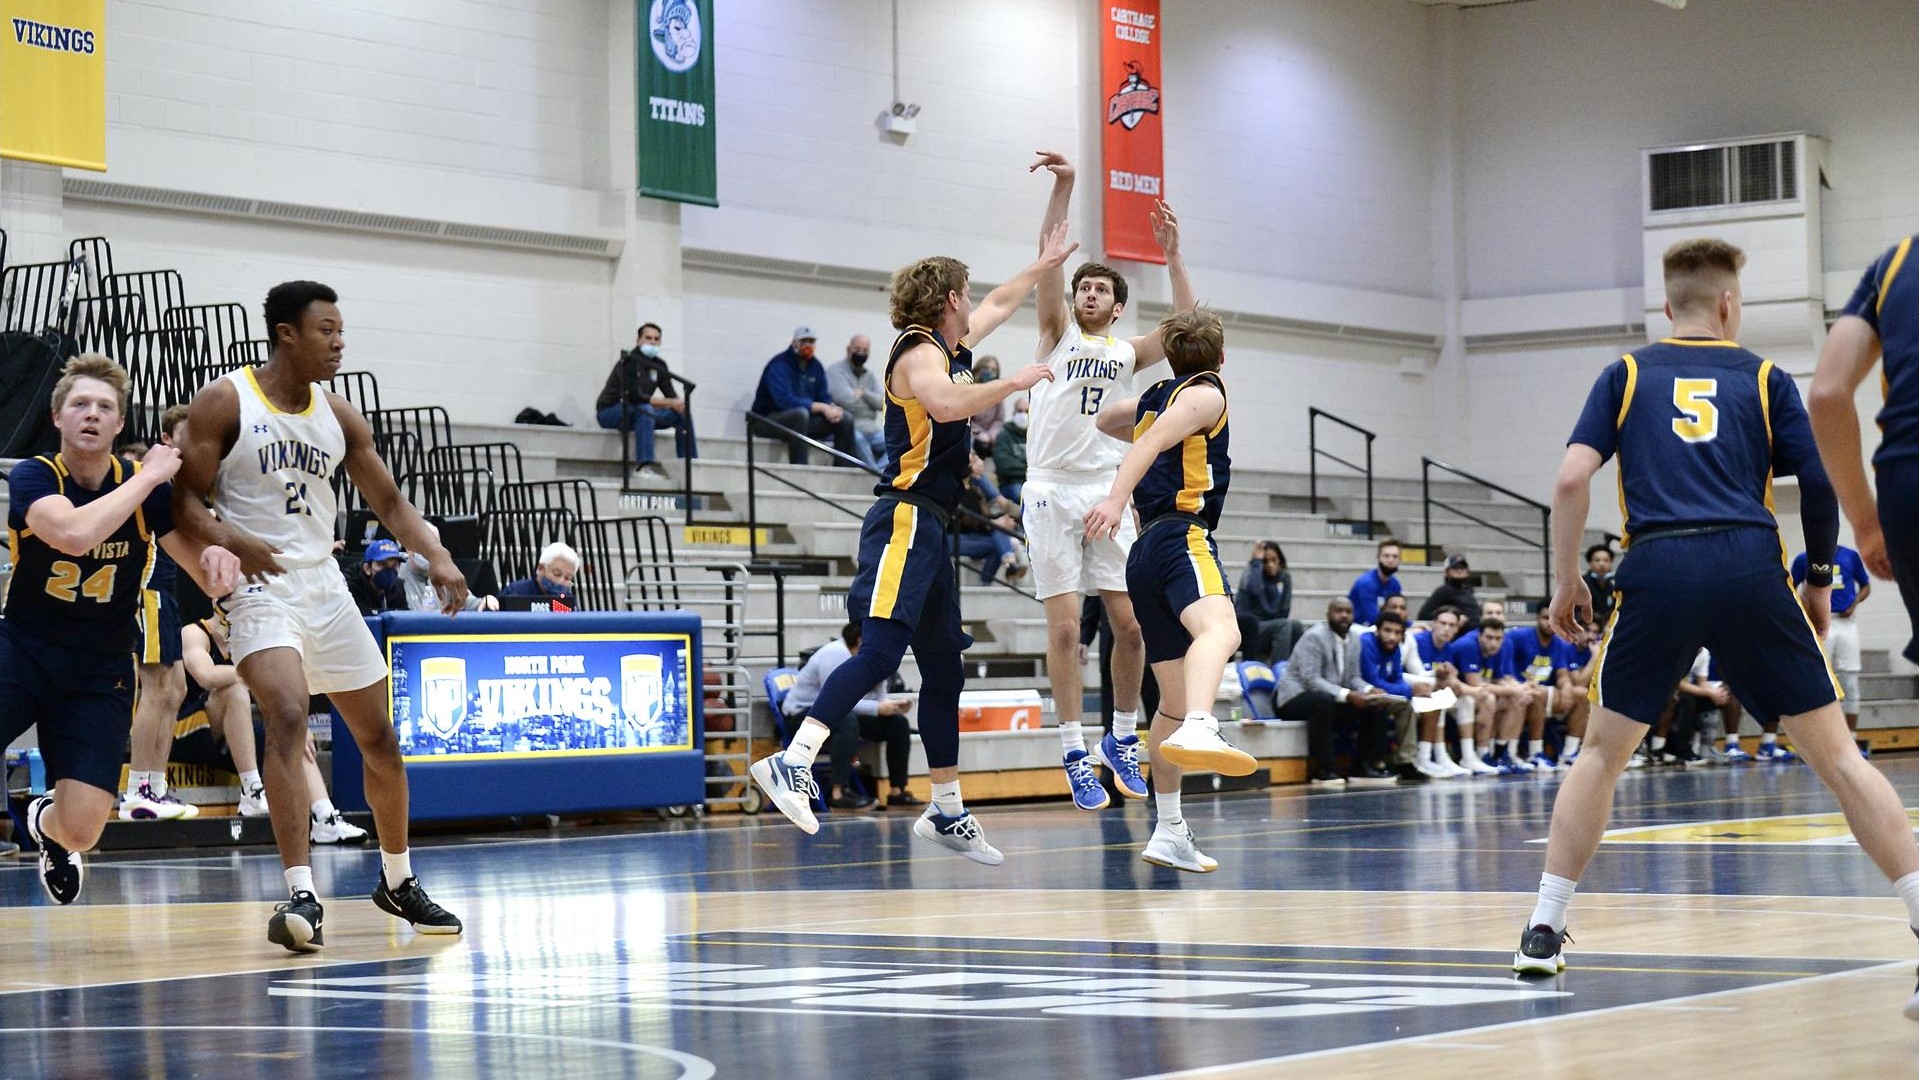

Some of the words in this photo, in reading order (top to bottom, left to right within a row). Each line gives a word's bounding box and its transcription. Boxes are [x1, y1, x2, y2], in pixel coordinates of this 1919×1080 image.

[1111, 7, 1155, 29] CARTHAGE
[12, 18, 95, 54] VIKINGS
[1115, 24, 1150, 44] COLLEGE
[649, 96, 705, 127] TITANS
[1110, 170, 1133, 191] RED
[1134, 174, 1160, 195] MEN
[1081, 386, 1104, 415] 13
[1672, 377, 1719, 443] 5
[258, 440, 330, 479] VIKINGS
[286, 482, 312, 516] 21
[93, 541, 129, 559] VISTA
[692, 529, 731, 544] VIKINGS
[45, 560, 118, 603] 24
[504, 655, 549, 675] NORTH
[549, 655, 585, 674] PARK
[478, 677, 613, 729] VIKINGS
